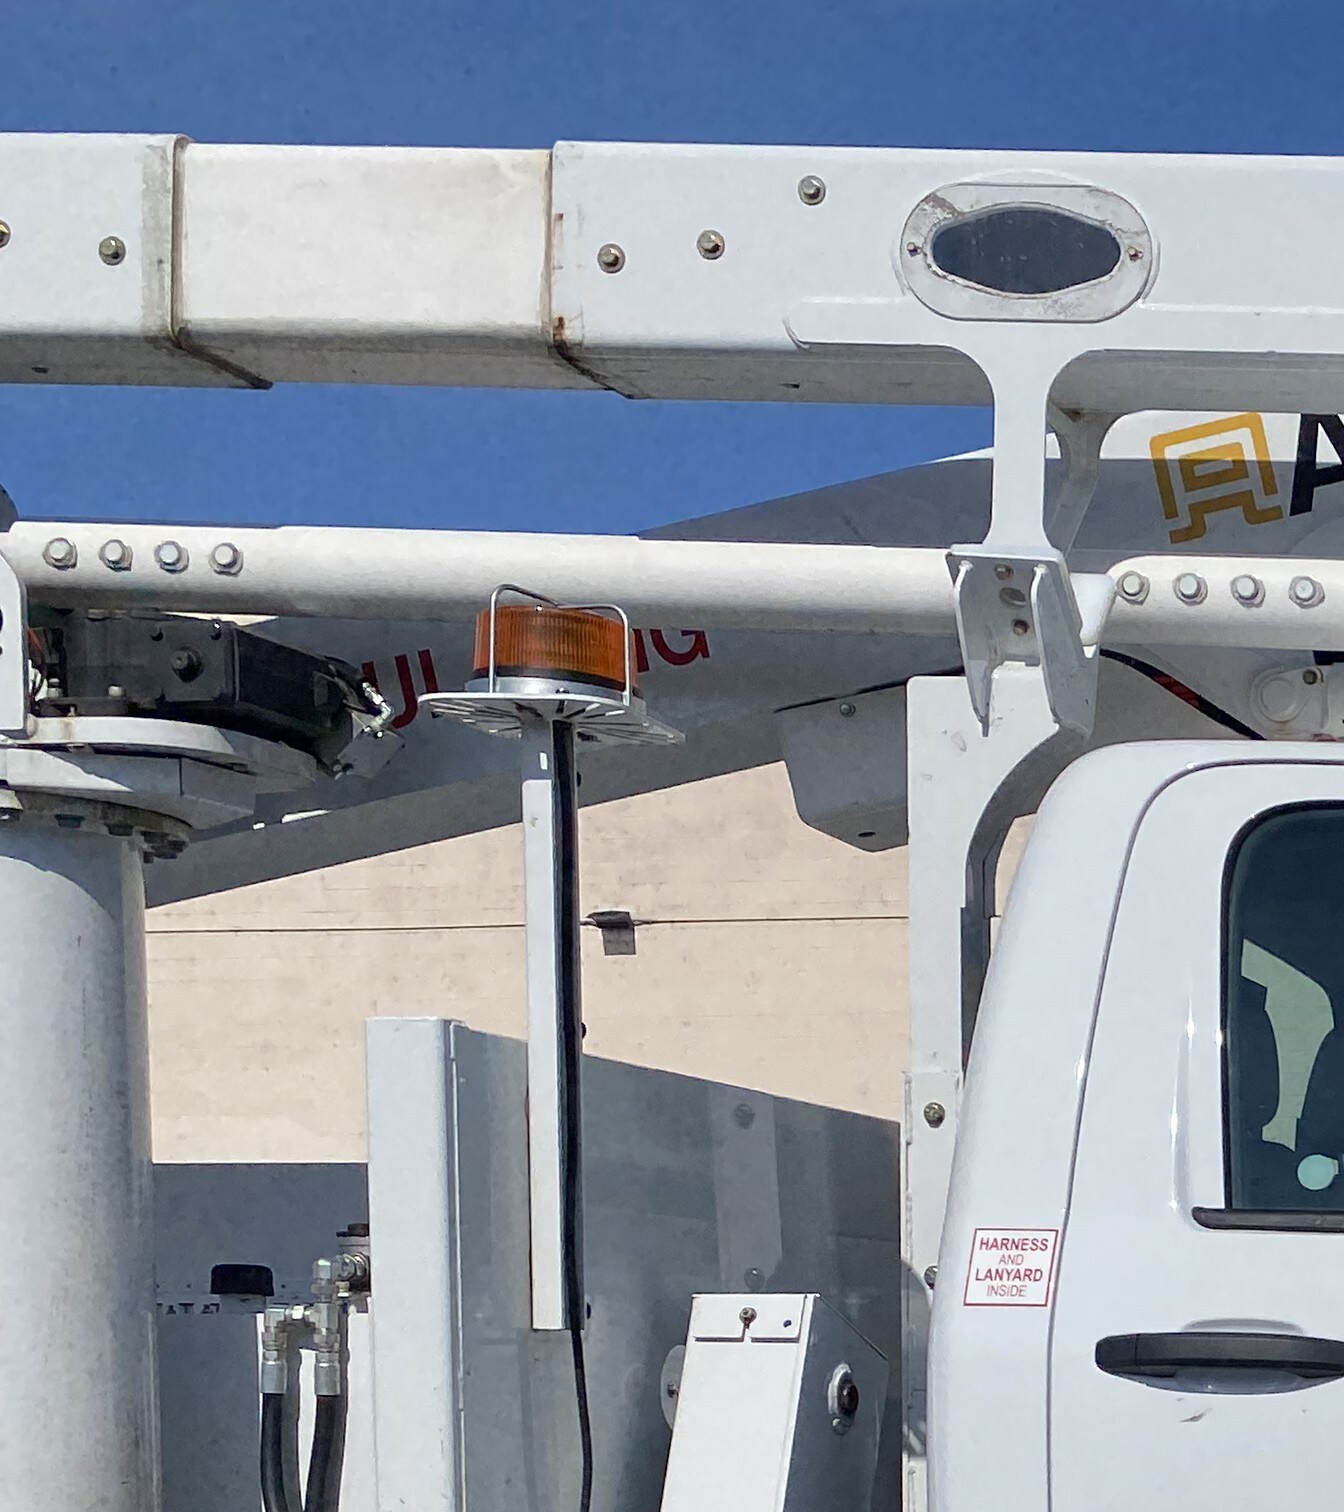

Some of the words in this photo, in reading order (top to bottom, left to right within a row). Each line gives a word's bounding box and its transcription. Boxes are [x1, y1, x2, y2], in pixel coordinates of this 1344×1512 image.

[979, 1236, 1050, 1252] HARNESS
[998, 1253, 1025, 1266] AND
[974, 1267, 1044, 1283] LANYARD
[985, 1284, 1028, 1298] INSIDE
